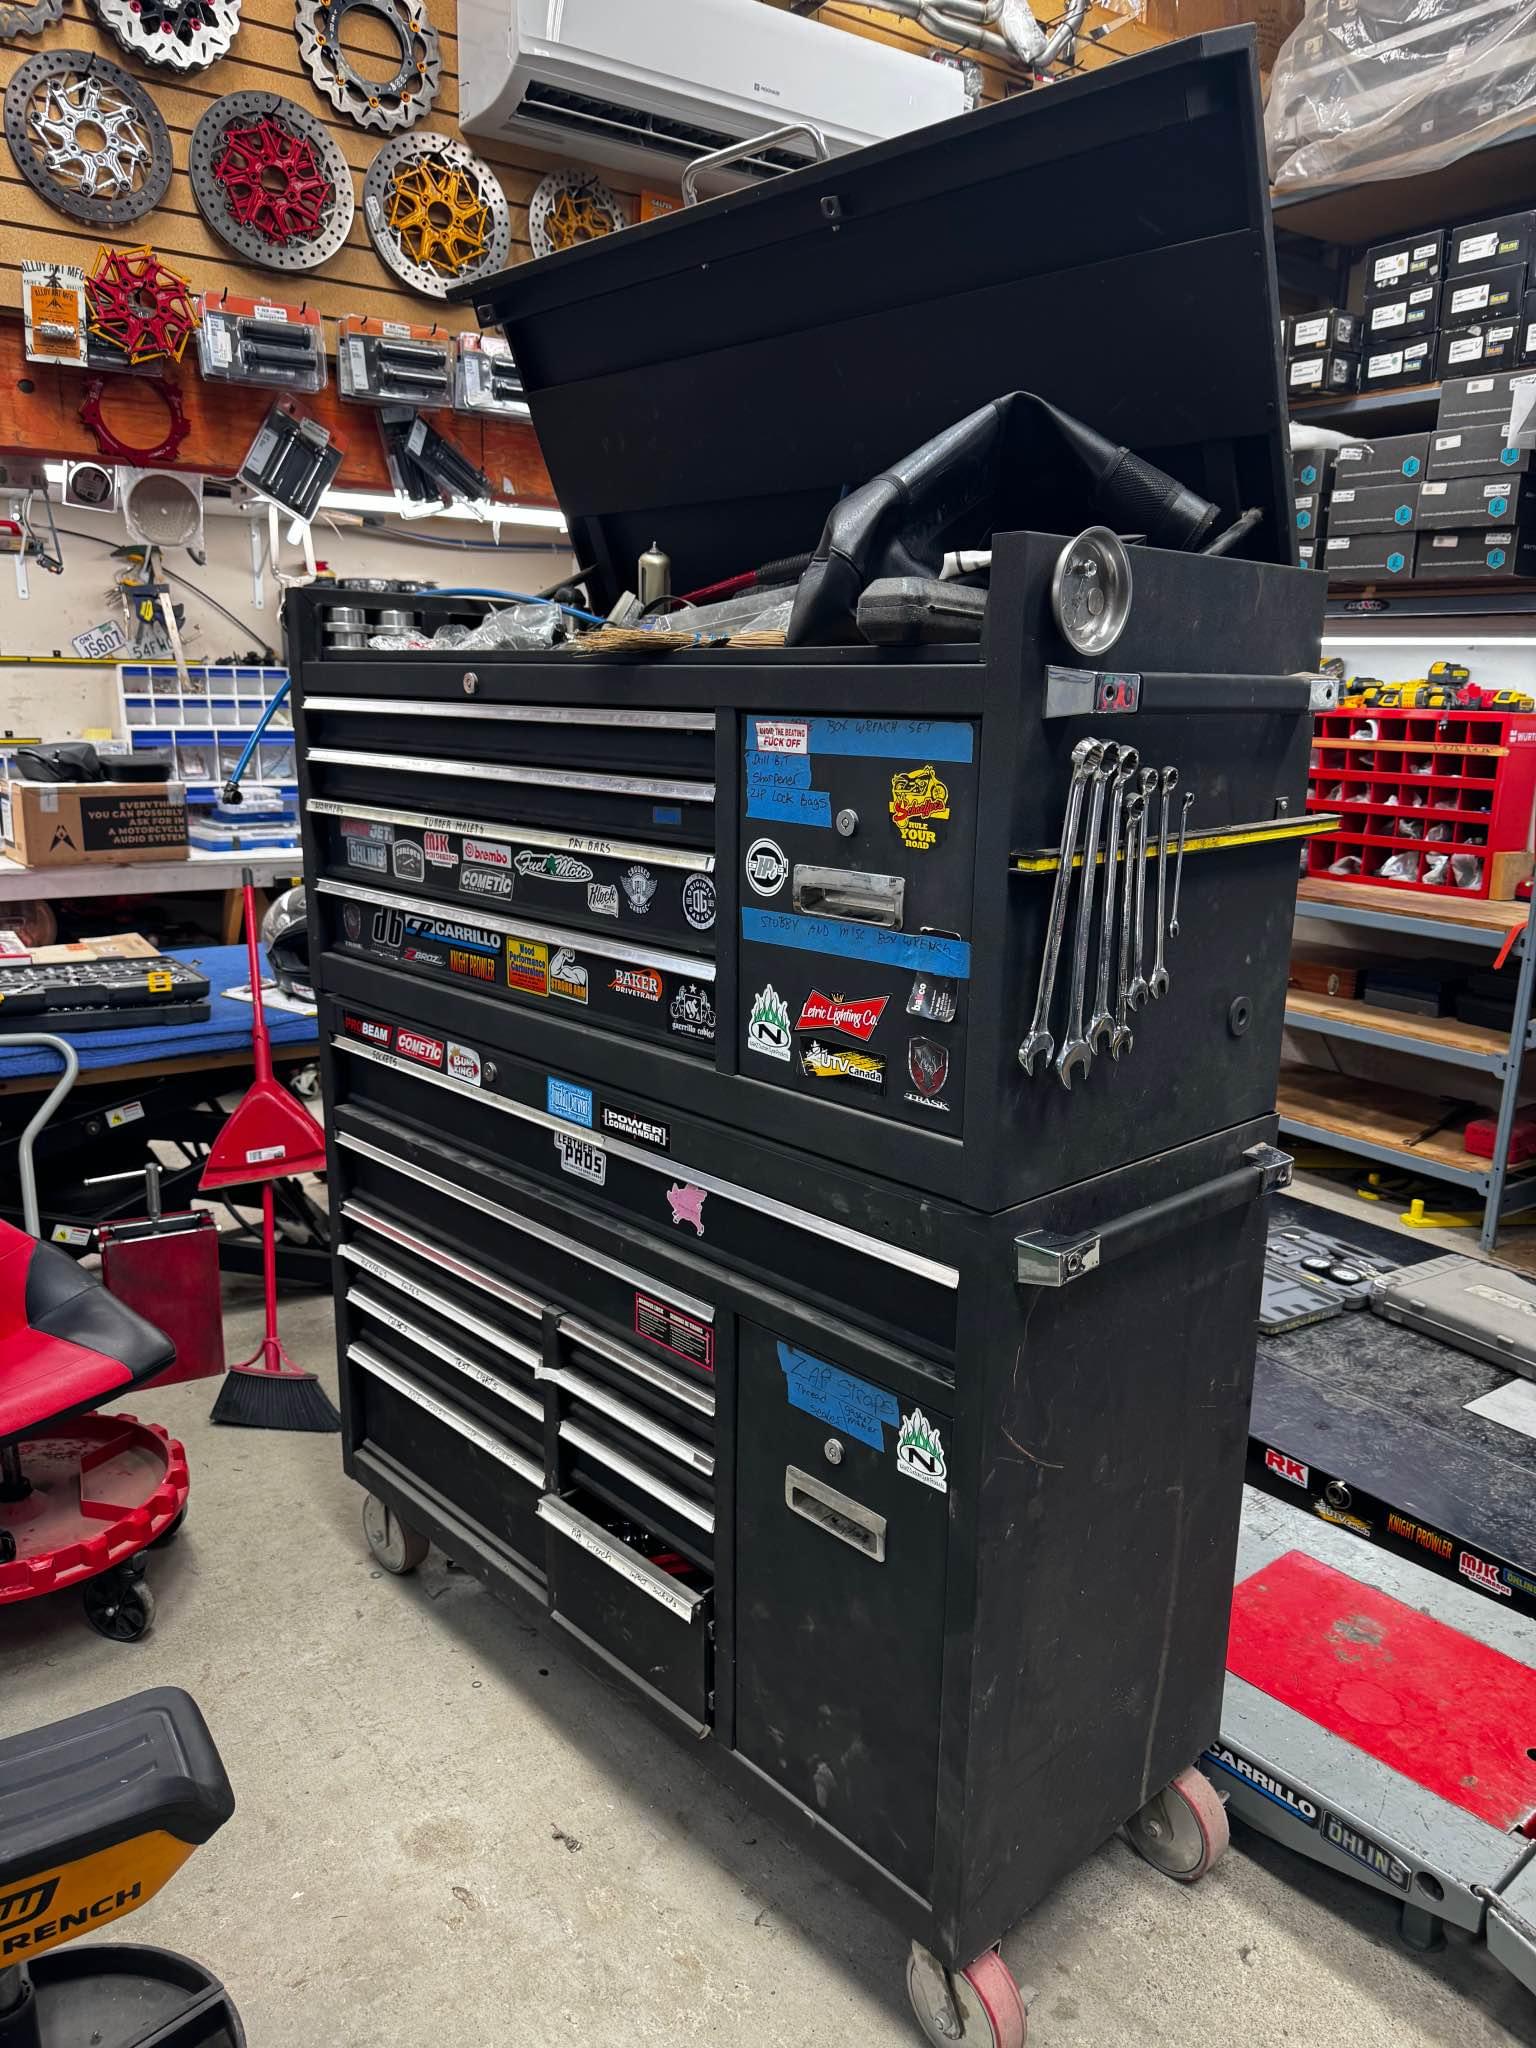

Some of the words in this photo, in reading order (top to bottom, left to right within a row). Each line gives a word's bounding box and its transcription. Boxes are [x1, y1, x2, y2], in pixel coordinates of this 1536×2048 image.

[79, 634, 93, 645] ONT
[775, 727, 784, 736] THE
[785, 728, 805, 737] BEATING
[908, 721, 933, 734] SET
[763, 737, 784, 747] FUCK
[786, 739, 802, 748] OFF
[88, 810, 109, 819] YOU
[112, 810, 134, 819] CAN
[136, 808, 184, 817] POSSIBLY
[129, 818, 150, 826] ASK
[152, 817, 172, 825] FOR
[108, 827, 116, 836] A
[118, 825, 185, 835] MOTORCYCLE
[901, 828, 936, 843] YOUR
[908, 821, 928, 830] RULE
[114, 835, 145, 844] AUDIO
[148, 833, 186, 843] SYSTEM
[424, 834, 448, 852] MJK
[588, 842, 611, 854] BARS
[905, 840, 929, 850] ROAD
[474, 846, 508, 865] brembo
[520, 854, 547, 874] Fuel
[462, 869, 513, 894] COMETIC
[687, 881, 713, 898] ORIGINAL
[436, 921, 501, 949] CARRILLO
[808, 924, 829, 936] AND
[469, 953, 496, 982] PROWLER
[509, 950, 546, 969] Performance
[551, 977, 574, 994] STRONG
[615, 969, 658, 993] BAKER
[615, 985, 659, 1002] DRIVETRAIN
[802, 1002, 827, 1018] Letric
[827, 1004, 863, 1028] Lighting
[863, 1009, 878, 1026] Co.
[759, 1023, 781, 1045] N
[398, 1034, 441, 1060] COMETIC
[454, 1065, 475, 1078] KING
[821, 1052, 851, 1073] UTV
[903, 1092, 950, 1112] TRASK
[608, 1111, 662, 1136] POWER
[608, 1119, 661, 1144] COMMANDER
[558, 1133, 593, 1153] LEATHER
[565, 1145, 602, 1173] PROS
[791, 1353, 832, 1389] ZAP
[795, 1382, 828, 1404] Thread
[908, 1447, 936, 1473] N
[1266, 1449, 1305, 1482] RK
[1327, 1509, 1346, 1523] UTV
[1388, 1512, 1417, 1540] KNIGHT
[1416, 1526, 1453, 1560] PROWLER
[1461, 1552, 1499, 1581] MJK
[1460, 1566, 1511, 1595] PERFORMANCE
[1208, 1744, 1317, 1820] CARRILLO
[1328, 1817, 1404, 1885] ÖHLINS
